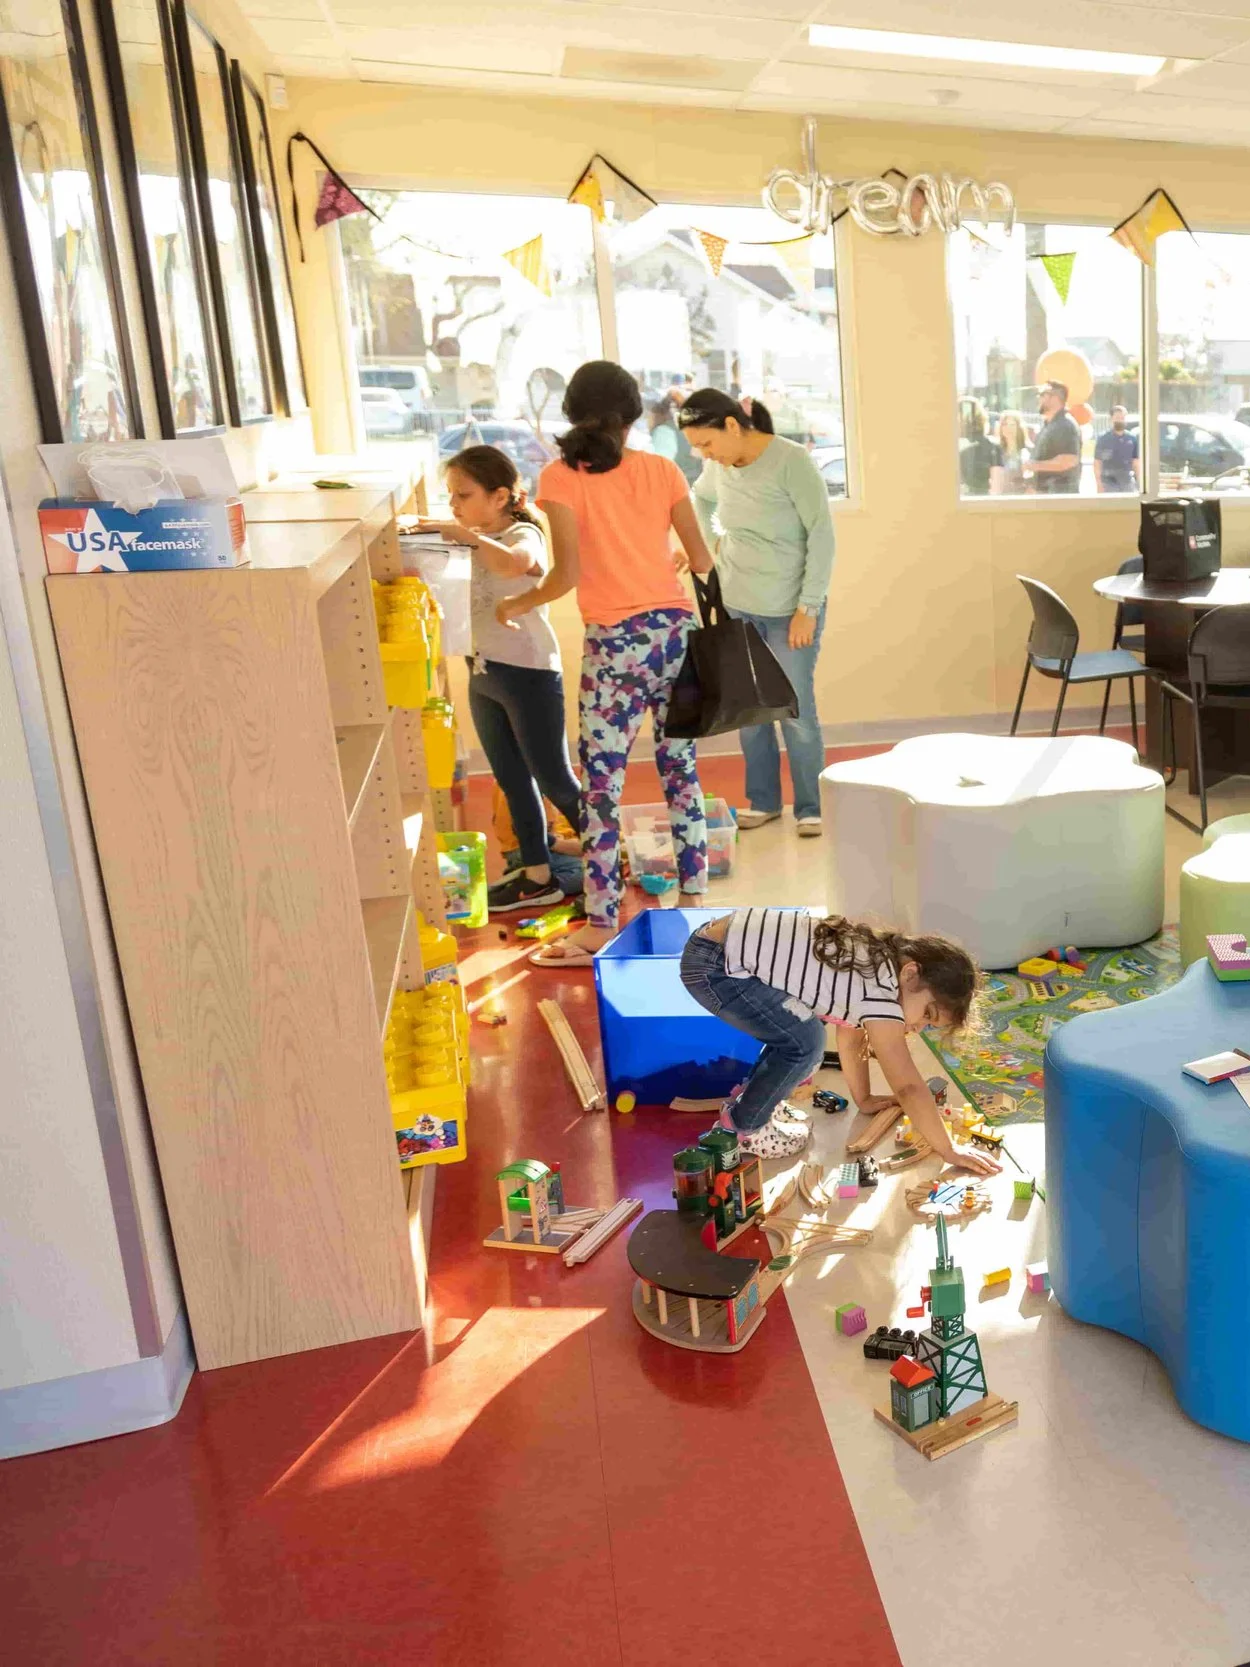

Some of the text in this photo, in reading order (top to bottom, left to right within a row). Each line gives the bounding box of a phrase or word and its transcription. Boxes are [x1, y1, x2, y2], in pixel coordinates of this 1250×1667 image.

[762, 116, 1016, 237] dream
[65, 530, 201, 553] USA facemask
